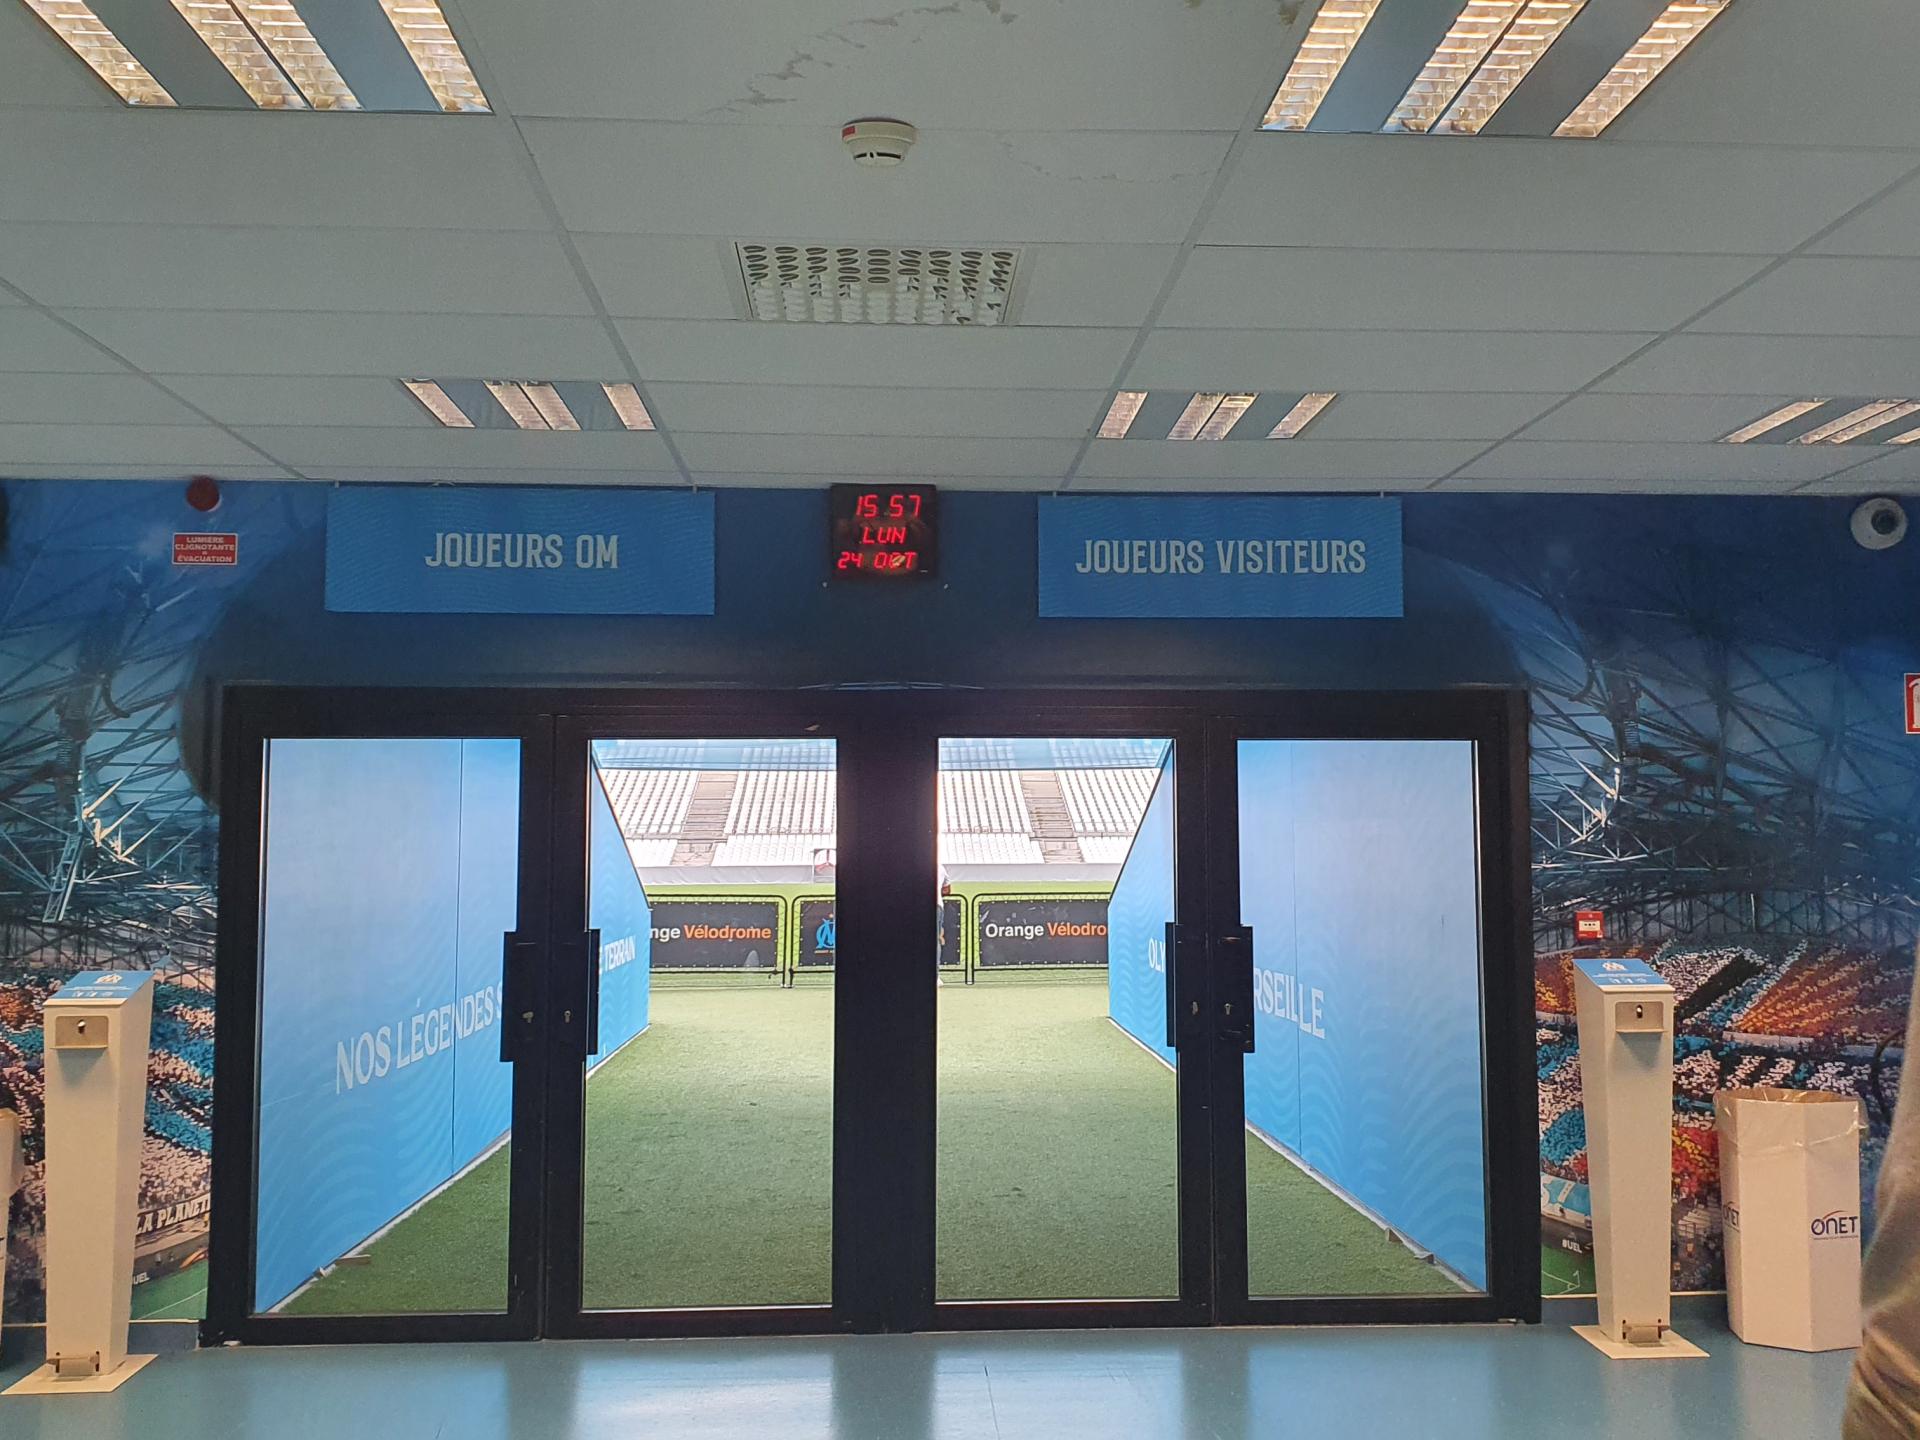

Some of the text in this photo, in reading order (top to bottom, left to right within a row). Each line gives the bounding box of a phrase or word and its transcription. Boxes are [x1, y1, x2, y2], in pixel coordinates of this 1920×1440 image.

[862, 526, 907, 544] LUN
[424, 532, 619, 569] JOUEURS OM
[837, 551, 864, 569] 24
[1075, 539, 1366, 574] JOUEURS VISITEURS
[649, 924, 772, 942] nge Vélodrome
[985, 922, 1107, 940] Orange Vélodro
[336, 1026, 391, 1095] NOS
[397, 998, 494, 1069] LÉGENDES
[604, 936, 636, 971] TERRAIN
[1253, 967, 1325, 1039] RSEILLE
